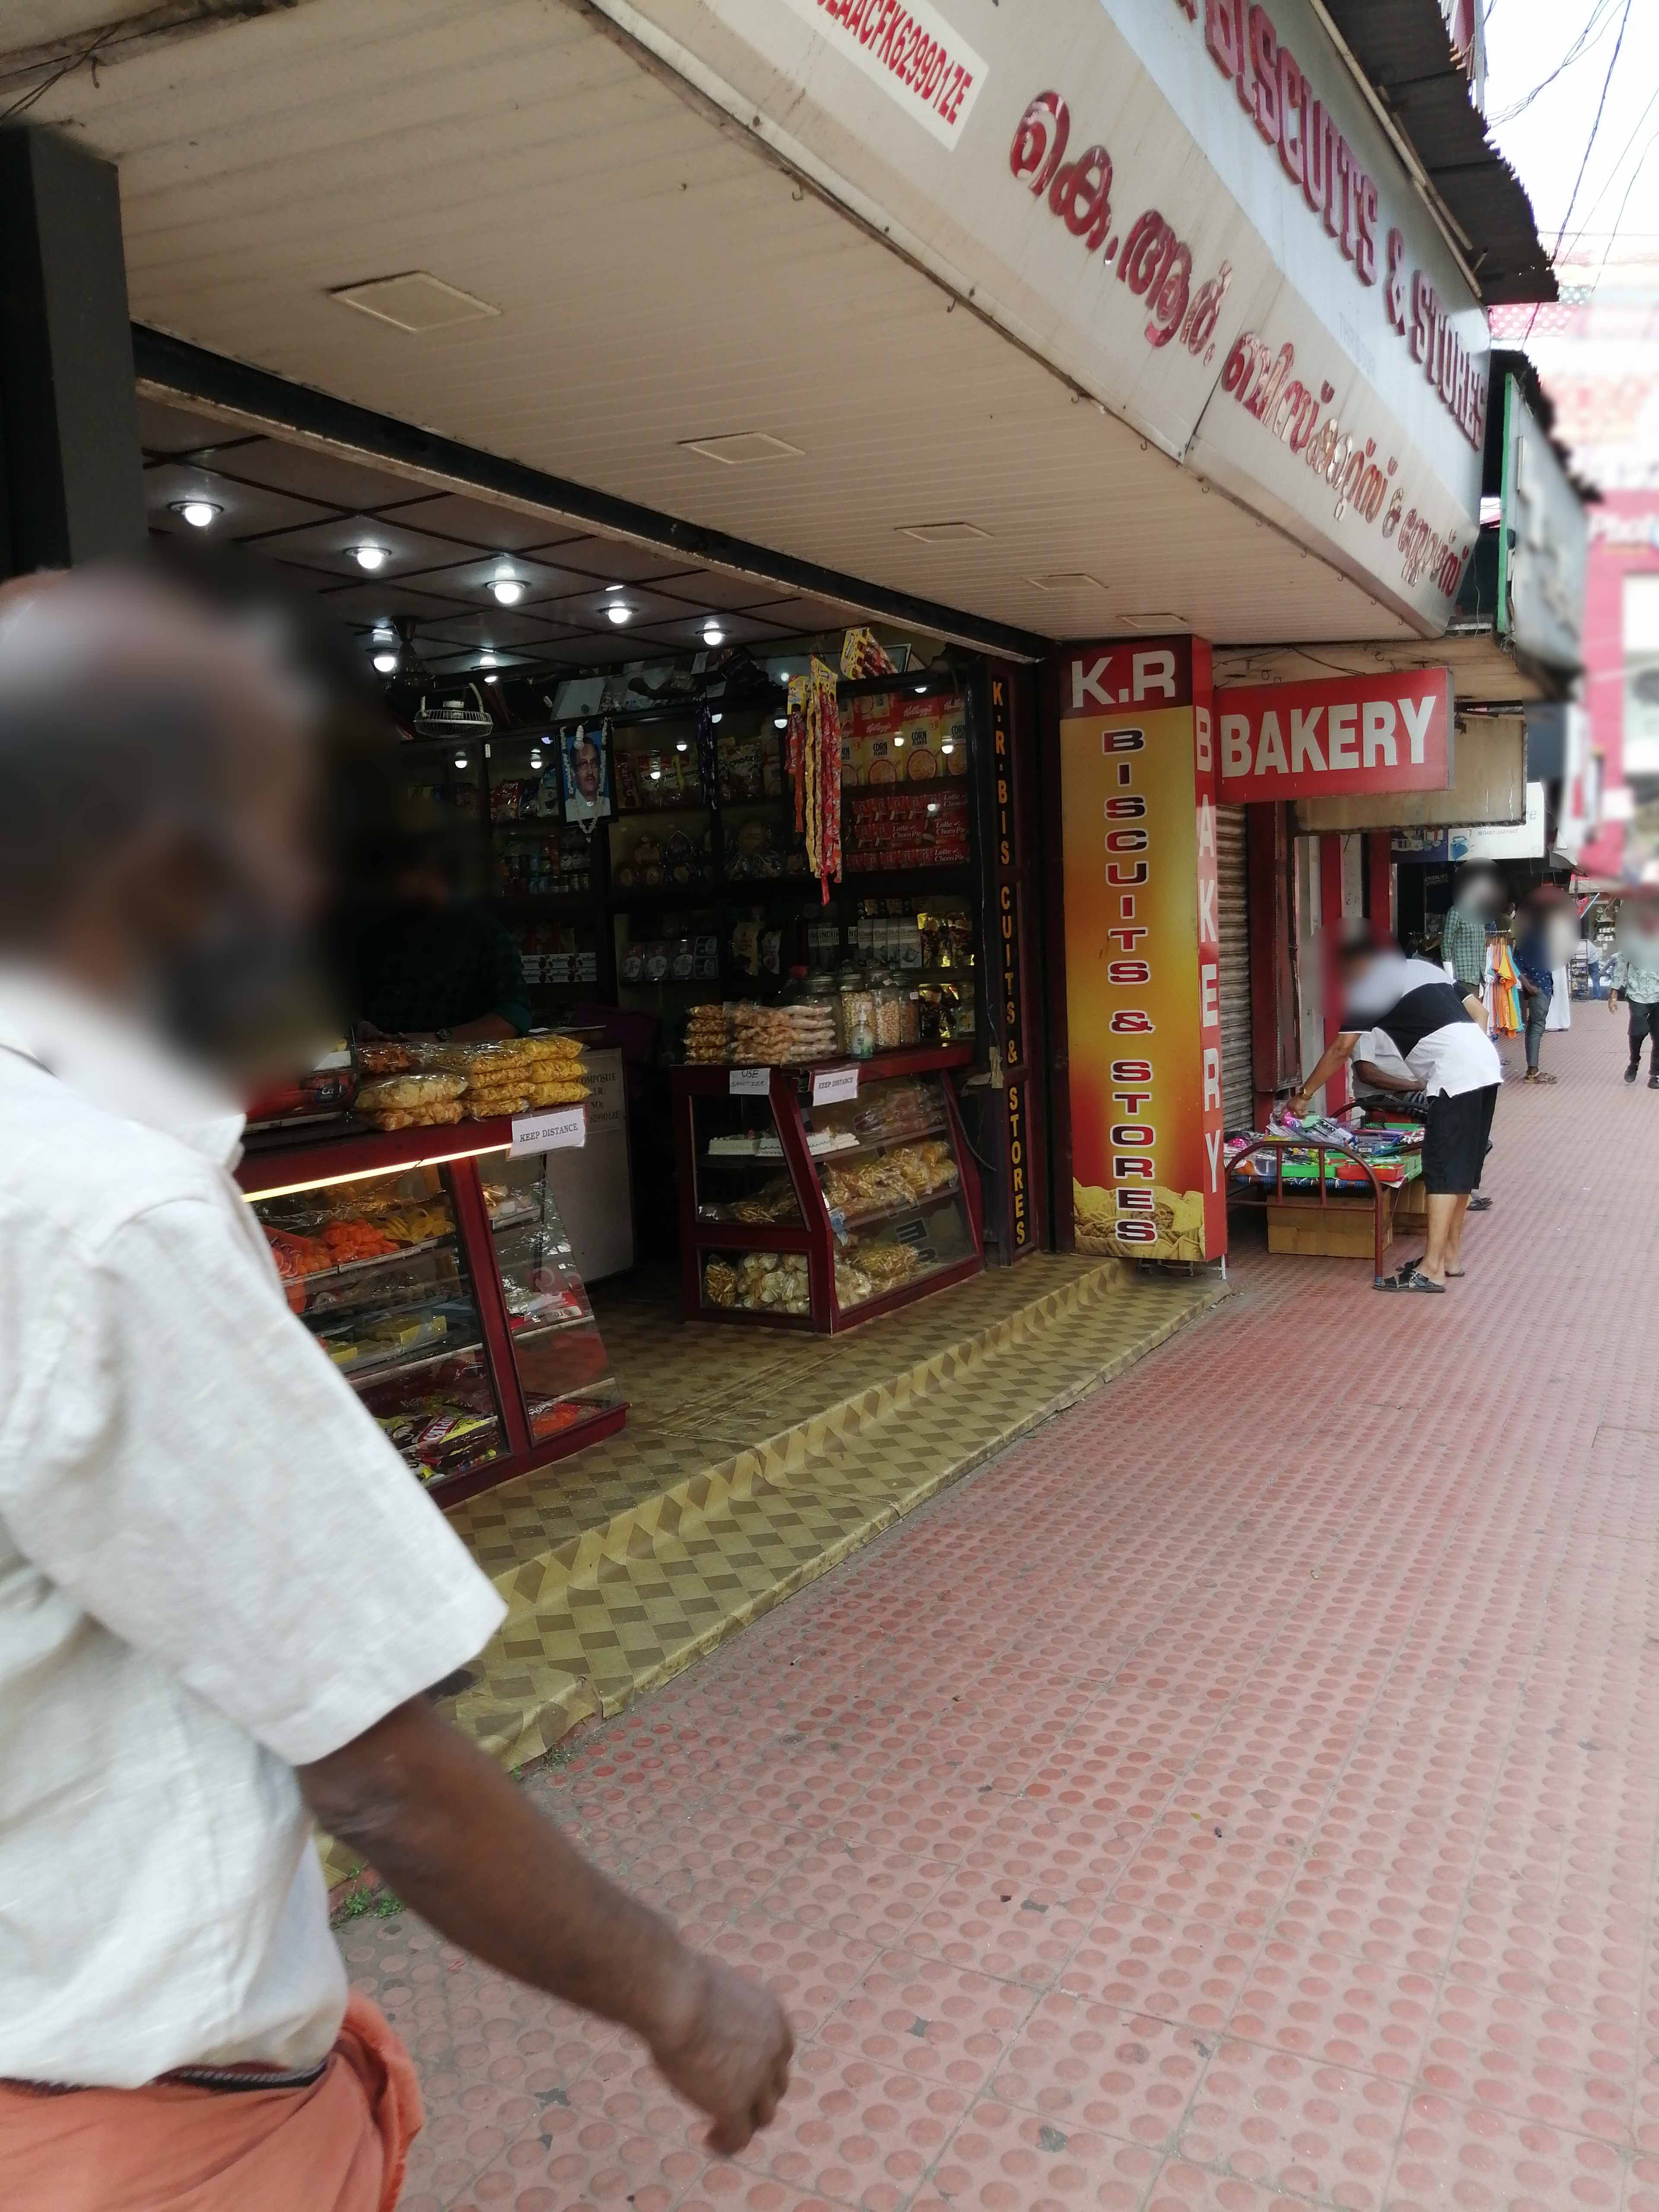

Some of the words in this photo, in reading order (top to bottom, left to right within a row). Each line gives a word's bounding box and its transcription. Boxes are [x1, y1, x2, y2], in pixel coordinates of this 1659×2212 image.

[817, 0, 973, 125] AACFK6299D1ZE
[1386, 227, 1405, 336] &
[1071, 649, 1176, 709] K.R
[873, 742, 887, 752] CORN
[912, 731, 927, 742] CORN
[1220, 696, 1436, 777] BAKERY
[1102, 727, 1151, 985] BISCUITS
[1196, 706, 1220, 1194] BAKERY
[1109, 1010, 1156, 1034] &
[741, 1069, 759, 1078] USE
[832, 1077, 853, 1087] DISTANCE
[519, 1131, 540, 1142] KEEP
[542, 1123, 578, 1138] DISTANCE
[1010, 1087, 1025, 1245] STORES
[1109, 1059, 1158, 1243] STORES
